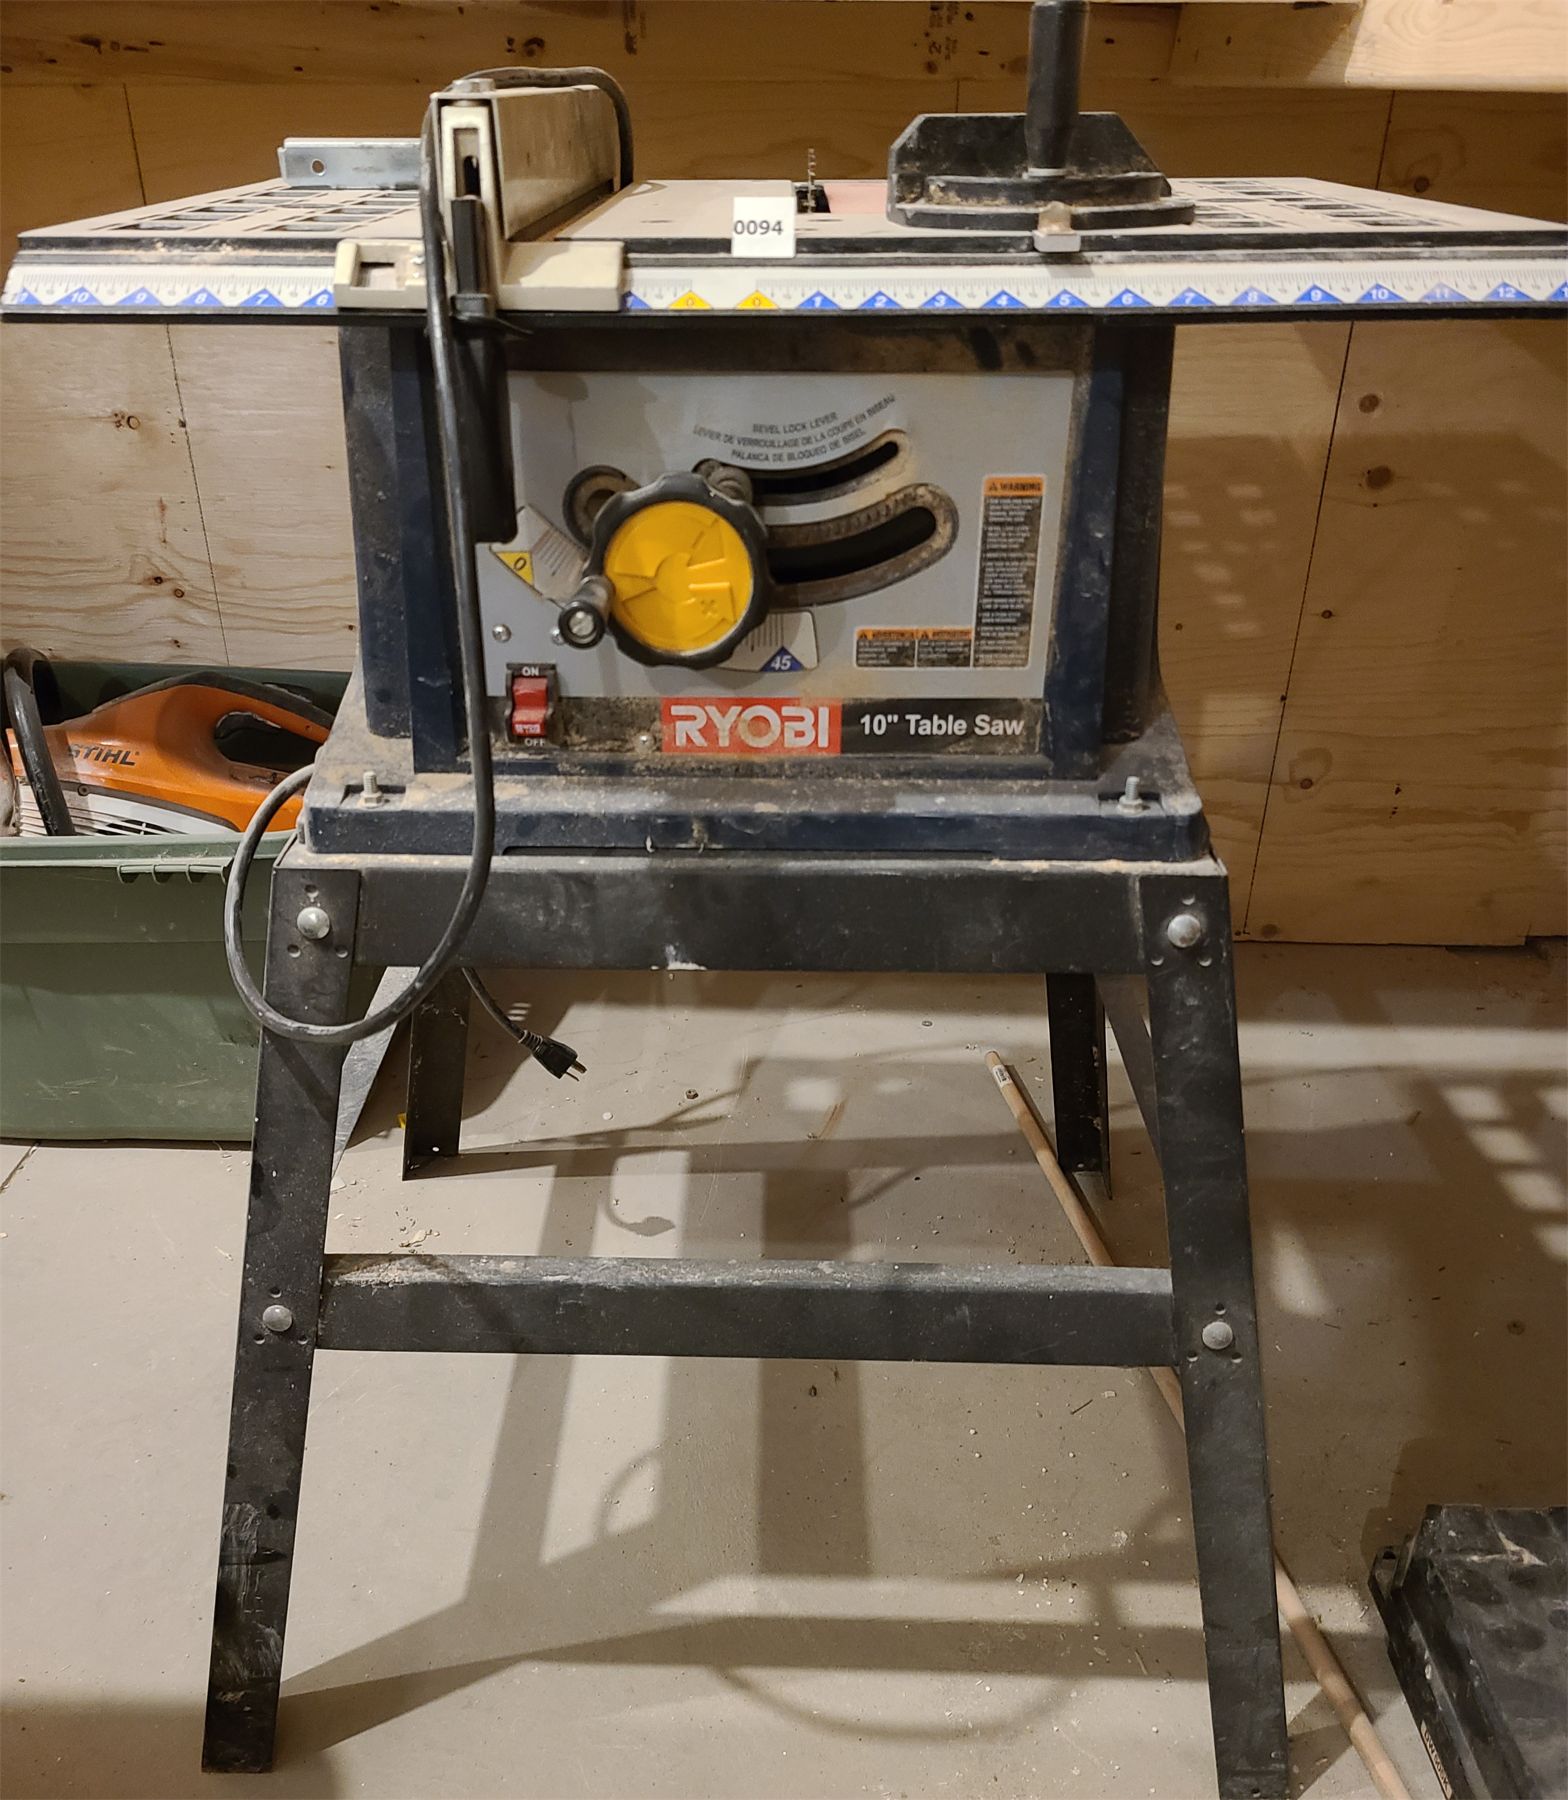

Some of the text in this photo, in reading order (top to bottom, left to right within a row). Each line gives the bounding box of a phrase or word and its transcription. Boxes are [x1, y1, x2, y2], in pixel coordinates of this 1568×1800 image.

[733, 220, 784, 236] 0094
[70, 291, 91, 304] 10
[134, 292, 149, 304] 9
[193, 292, 208, 304] 8
[254, 293, 269, 306] 7
[315, 293, 329, 306] 6
[685, 297, 695, 308] 0
[752, 297, 762, 308] 0
[813, 296, 823, 308] 1
[874, 295, 886, 308] 2
[934, 294, 946, 307] 3
[996, 294, 1008, 307] 4
[1058, 294, 1070, 307] 5
[1121, 293, 1133, 306] 6
[1183, 291, 1195, 305] 7
[1247, 290, 1259, 304] 8
[1310, 289, 1322, 302] 9
[1369, 288, 1389, 301] 10
[1434, 287, 1451, 300] 11
[1498, 286, 1517, 299] 12
[752, 411, 839, 435] BEVEL LOCK LEVER
[723, 433, 734, 445] DE
[801, 435, 813, 447] DE
[814, 432, 826, 443] LA
[731, 449, 770, 461] PALANCA
[771, 452, 784, 462] DE
[828, 439, 842, 451] DE
[512, 556, 527, 571] 0
[769, 654, 793, 671] 45
[521, 666, 540, 677] ON
[669, 704, 1025, 749] RYOBI 10" Table Saw
[524, 737, 546, 748] OFF
[67, 743, 137, 767] STIHL
